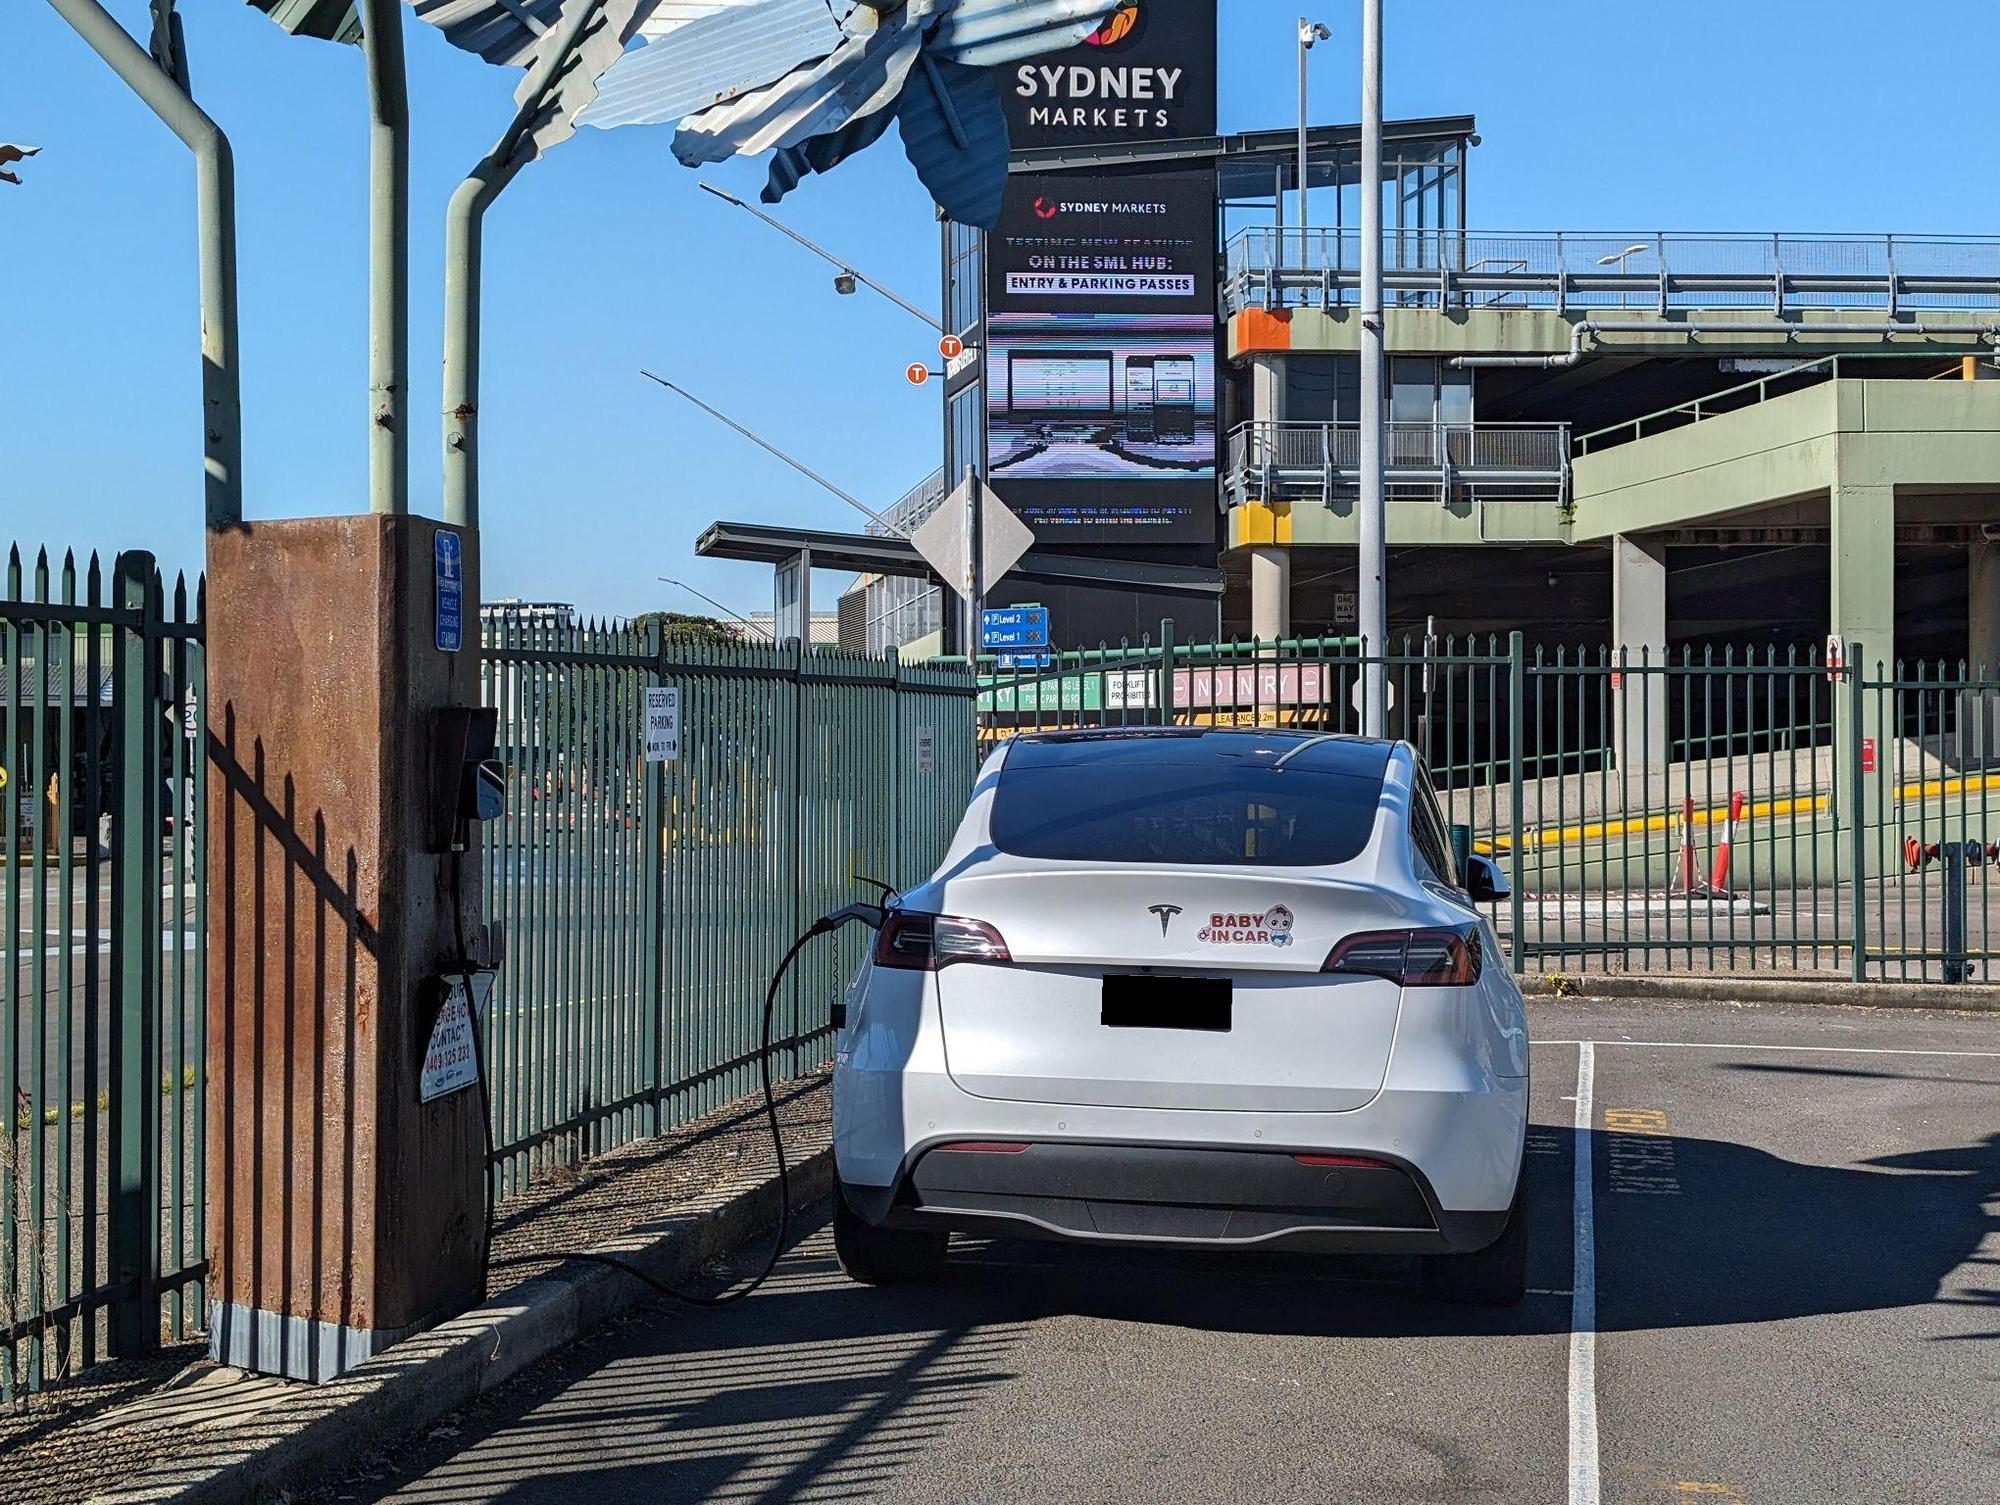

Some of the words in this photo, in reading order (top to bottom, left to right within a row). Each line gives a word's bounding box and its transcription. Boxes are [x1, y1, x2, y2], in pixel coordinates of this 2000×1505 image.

[1016, 65, 1182, 99] SYDNEY
[1030, 107, 1168, 127] MARKETS
[1060, 203, 1108, 213] SYDNEY
[1112, 203, 1166, 214] MARKETS
[1029, 255, 1055, 269] ON
[1058, 255, 1090, 270] THE
[1093, 256, 1128, 270] SML
[1131, 256, 1173, 271] HUB:
[1011, 277, 1055, 289] ENTRY
[1058, 278, 1068, 289] &
[1071, 278, 1136, 290] PARKING
[1140, 278, 1190, 290] PASSES
[945, 340, 957, 355] T
[912, 367, 923, 381] T
[1337, 595, 1353, 603] ONE
[1336, 604, 1354, 612] WAY
[1000, 615, 1015, 624] Level
[1016, 614, 1021, 623] 2
[1000, 632, 1015, 641] Level
[1112, 680, 1144, 689] FOKLIFT
[1198, 678, 1223, 697] NO
[648, 693, 675, 708] RESERVED
[650, 715, 673, 730] PARKING
[1216, 713, 1255, 723] LEARANCE
[1211, 915, 1264, 927] BABY
[1211, 930, 1229, 942] IN
[1232, 930, 1269, 942] CAR
[430, 1023, 466, 1050] CONTACT
